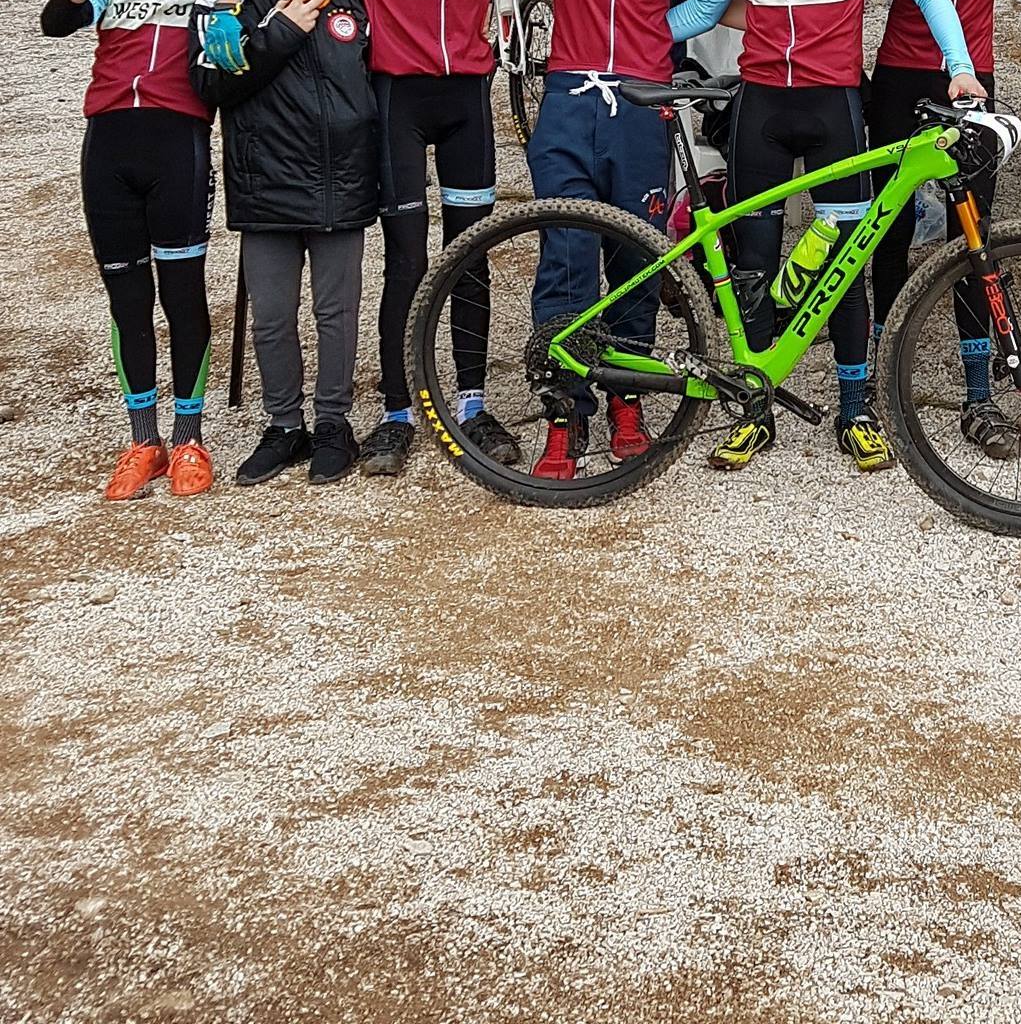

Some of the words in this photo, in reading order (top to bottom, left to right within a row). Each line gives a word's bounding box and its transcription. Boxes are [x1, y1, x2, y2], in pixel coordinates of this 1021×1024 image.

[113, 2, 161, 20] WEST
[793, 201, 894, 338] PROTEK
[420, 389, 465, 457] MAXXIS
